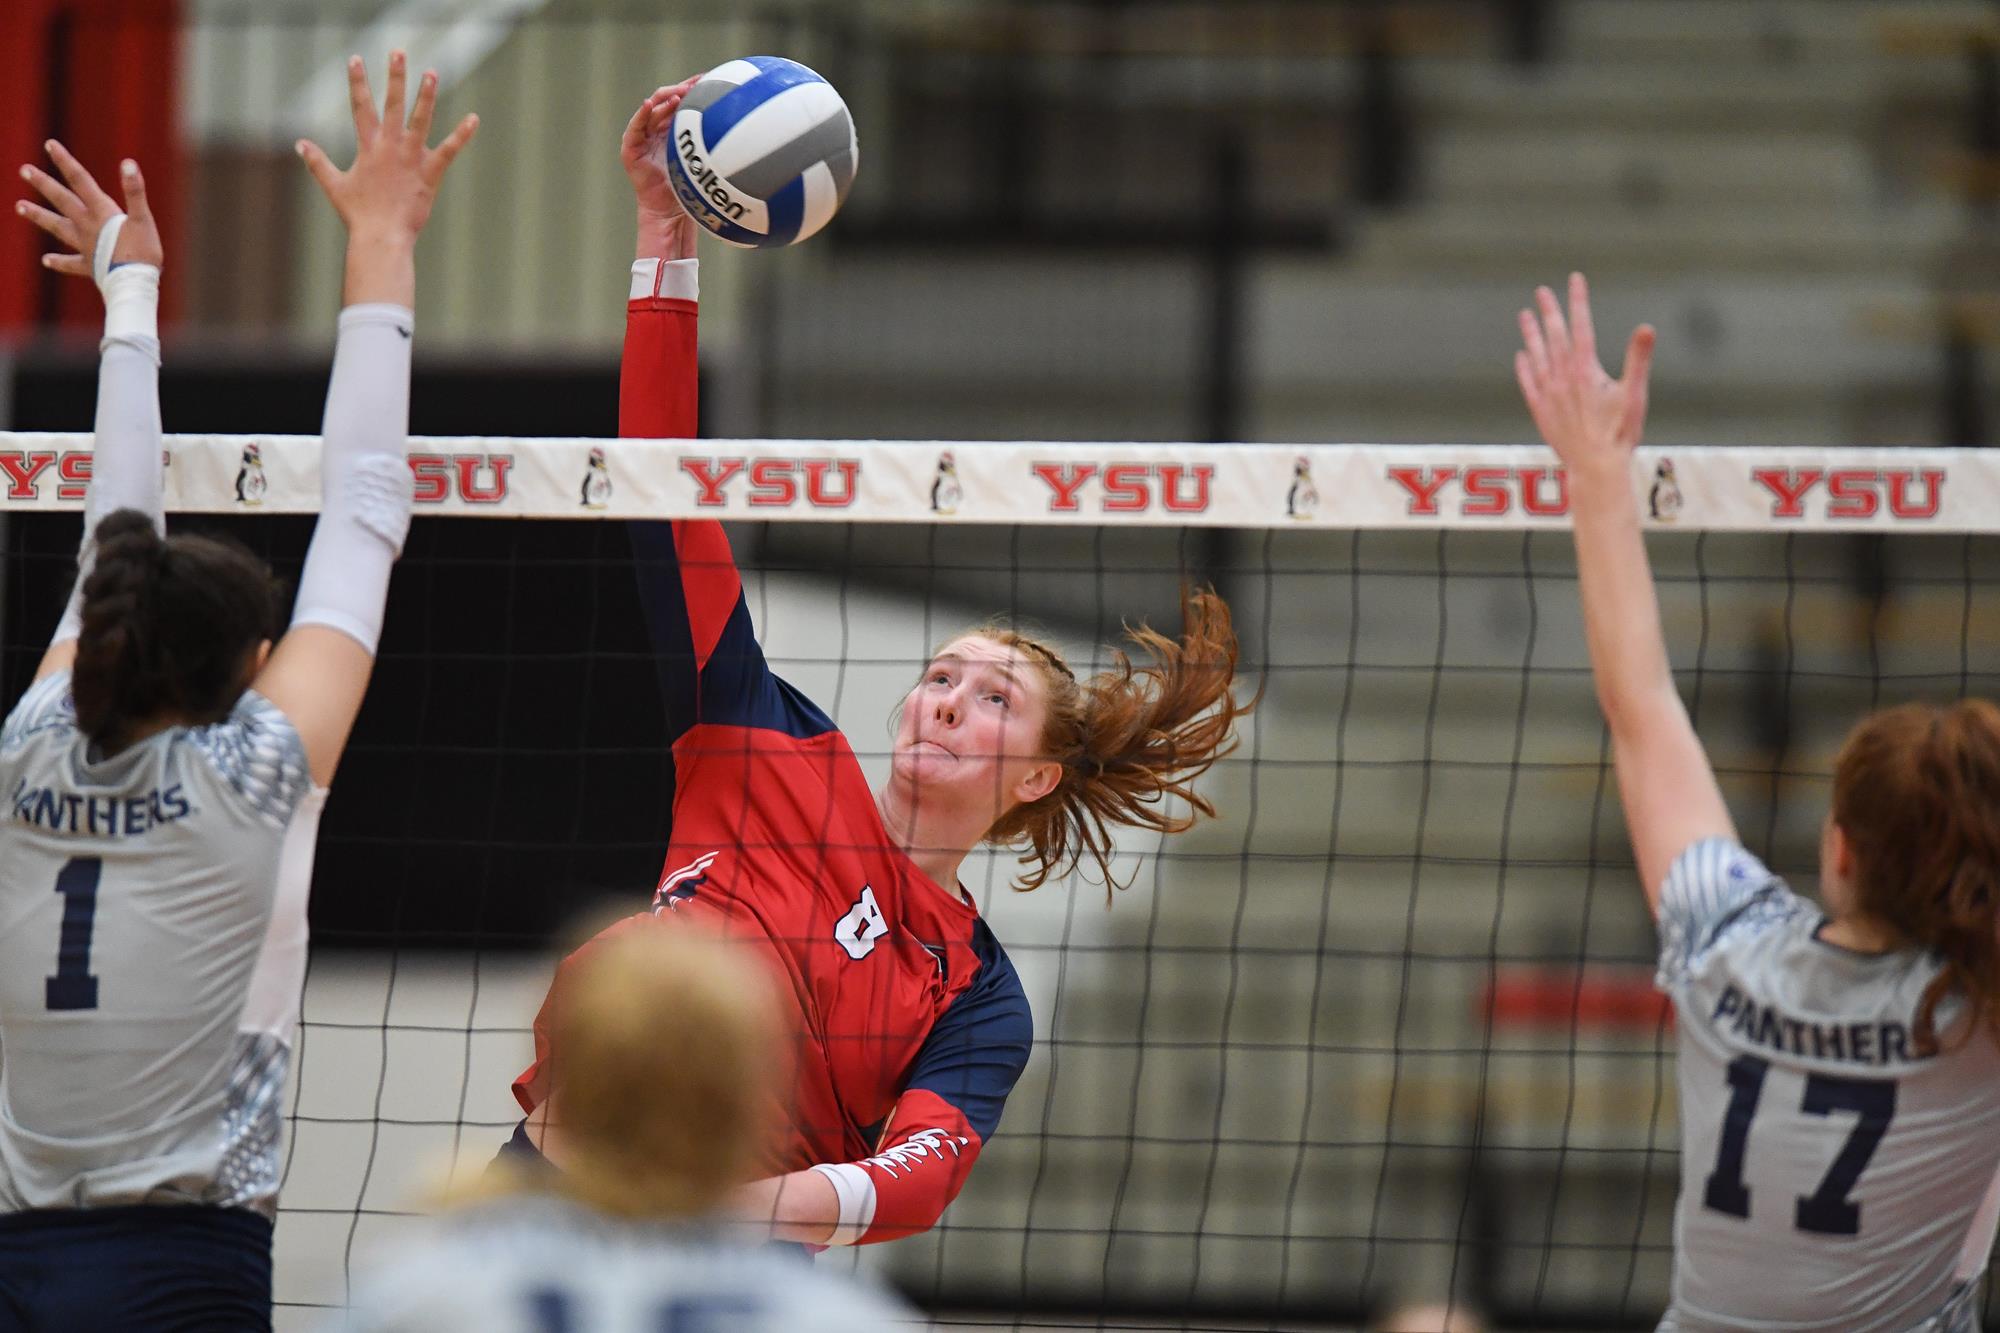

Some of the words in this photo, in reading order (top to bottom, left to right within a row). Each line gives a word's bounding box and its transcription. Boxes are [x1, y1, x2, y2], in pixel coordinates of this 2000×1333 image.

[678, 128, 747, 221] molten
[407, 453, 514, 504] SU
[678, 455, 860, 508] YSU
[1029, 461, 1215, 513] YSU
[1385, 464, 1570, 516] YSU
[1751, 466, 1948, 519] YSU
[45, 856, 103, 1012] 1
[834, 883, 889, 960] 8
[1713, 983, 1937, 1064] PANTHER
[1704, 1052, 1897, 1236] 17
